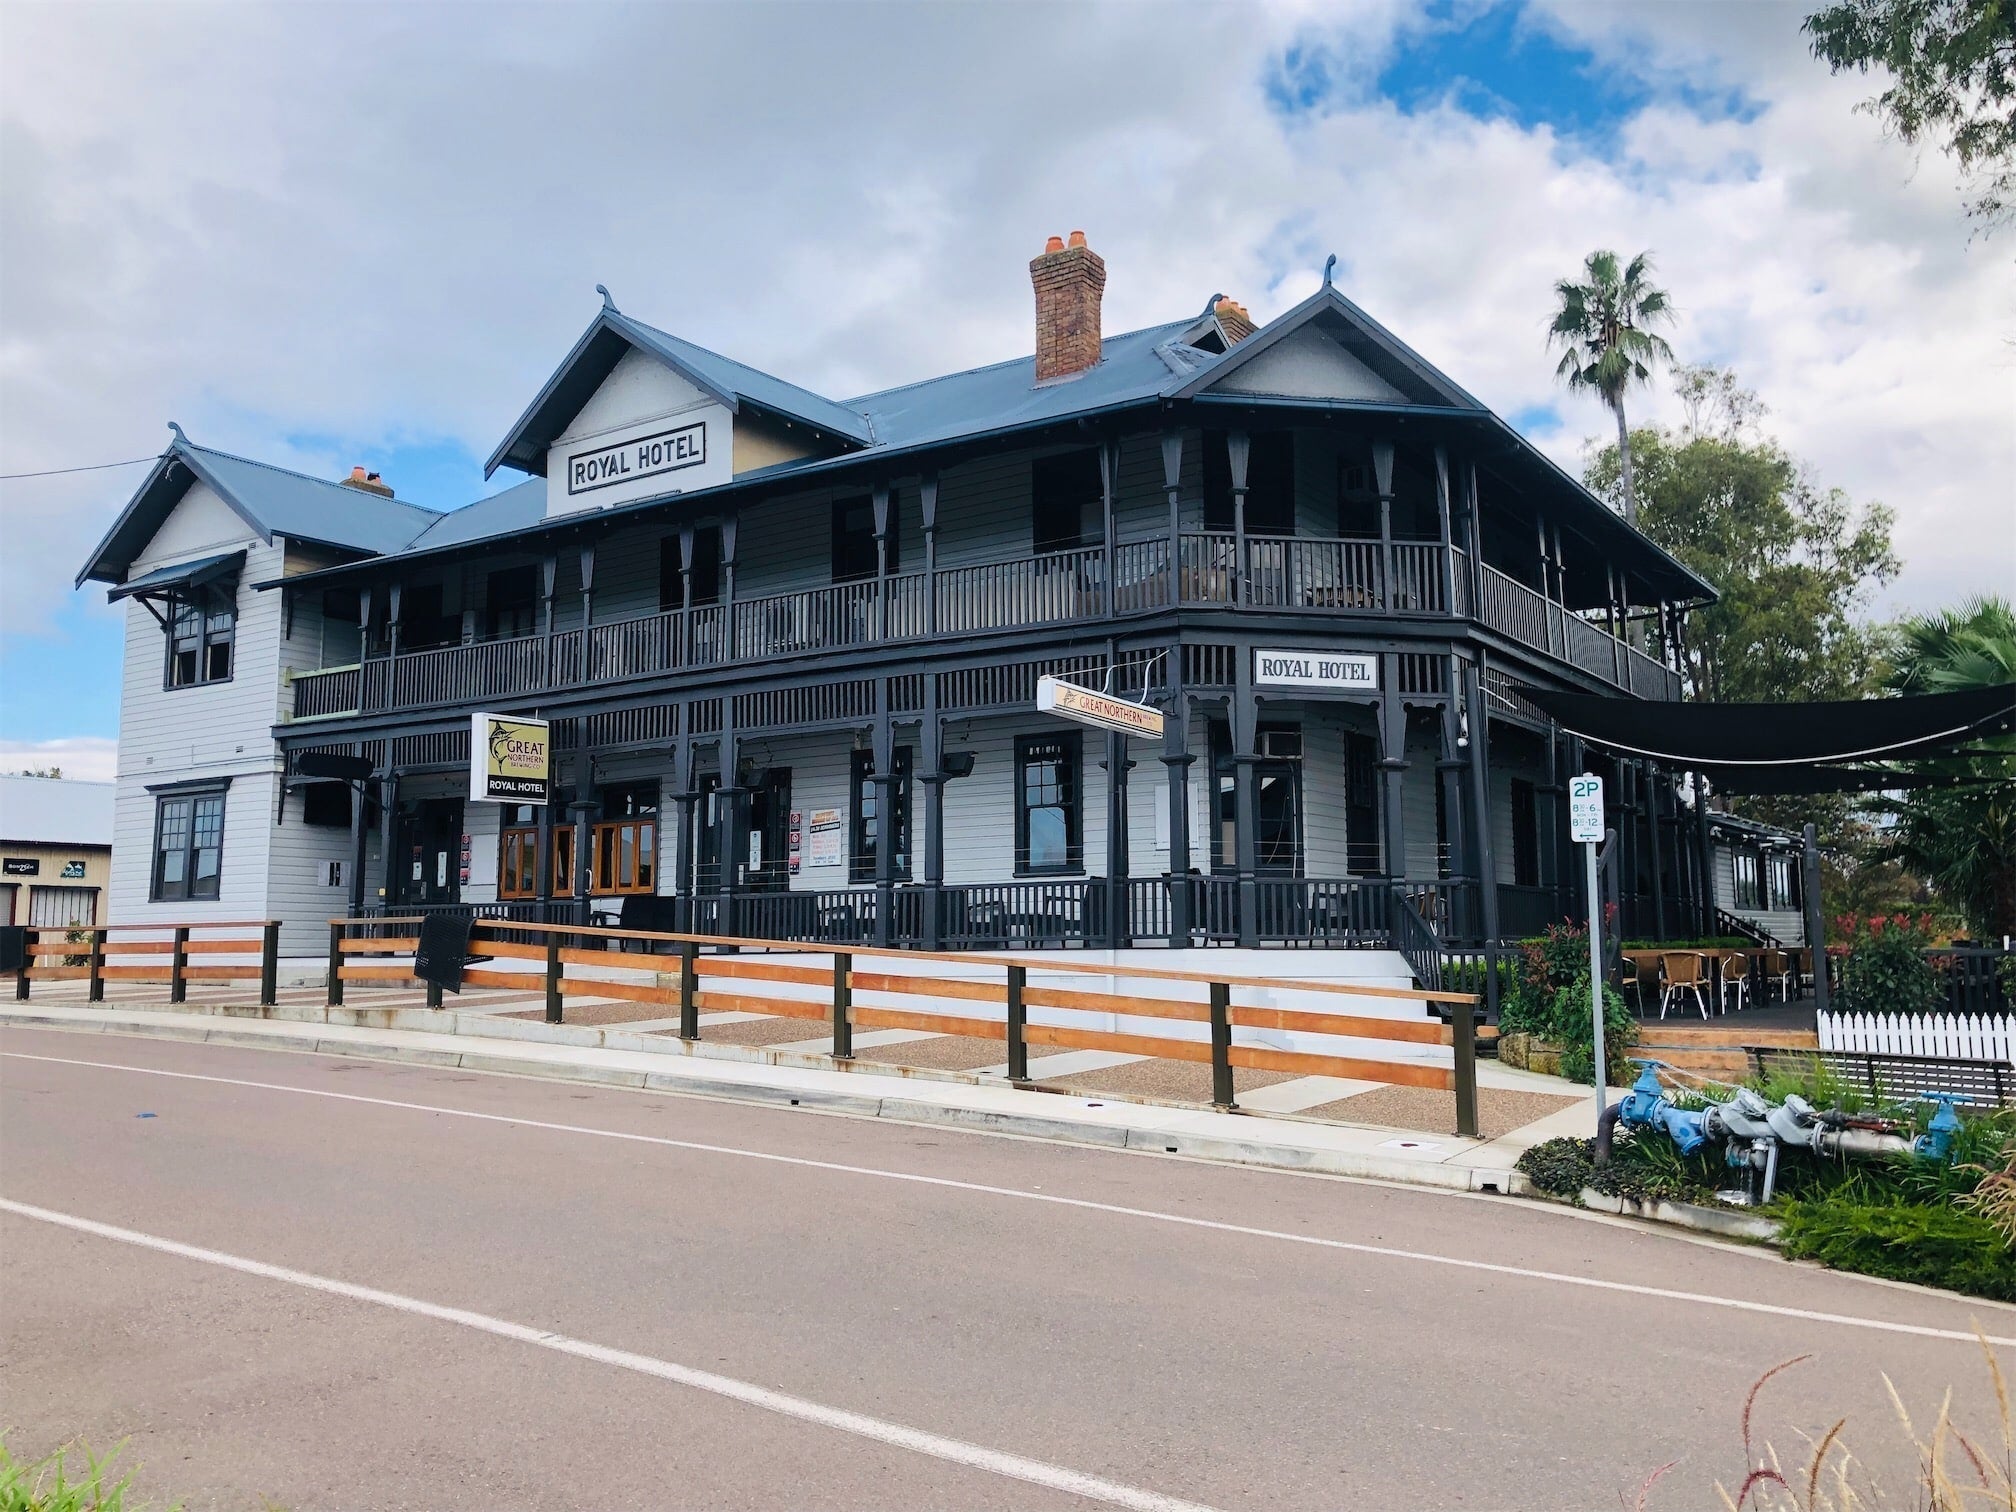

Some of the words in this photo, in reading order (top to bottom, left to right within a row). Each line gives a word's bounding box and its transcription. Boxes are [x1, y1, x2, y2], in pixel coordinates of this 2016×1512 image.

[575, 452, 631, 485] ROYAL
[639, 434, 700, 469] HOTEL
[1261, 658, 1313, 678] ROYAL
[1318, 661, 1370, 681] HOTEL
[1080, 696, 1103, 714] GREAT
[1103, 703, 1143, 724] NORTHERN
[507, 740, 545, 756] GREAT
[507, 753, 545, 764] NORTHERN
[489, 780, 517, 791] ROYAL
[518, 782, 545, 793] HOTEL
[1574, 781, 1599, 797] 2P
